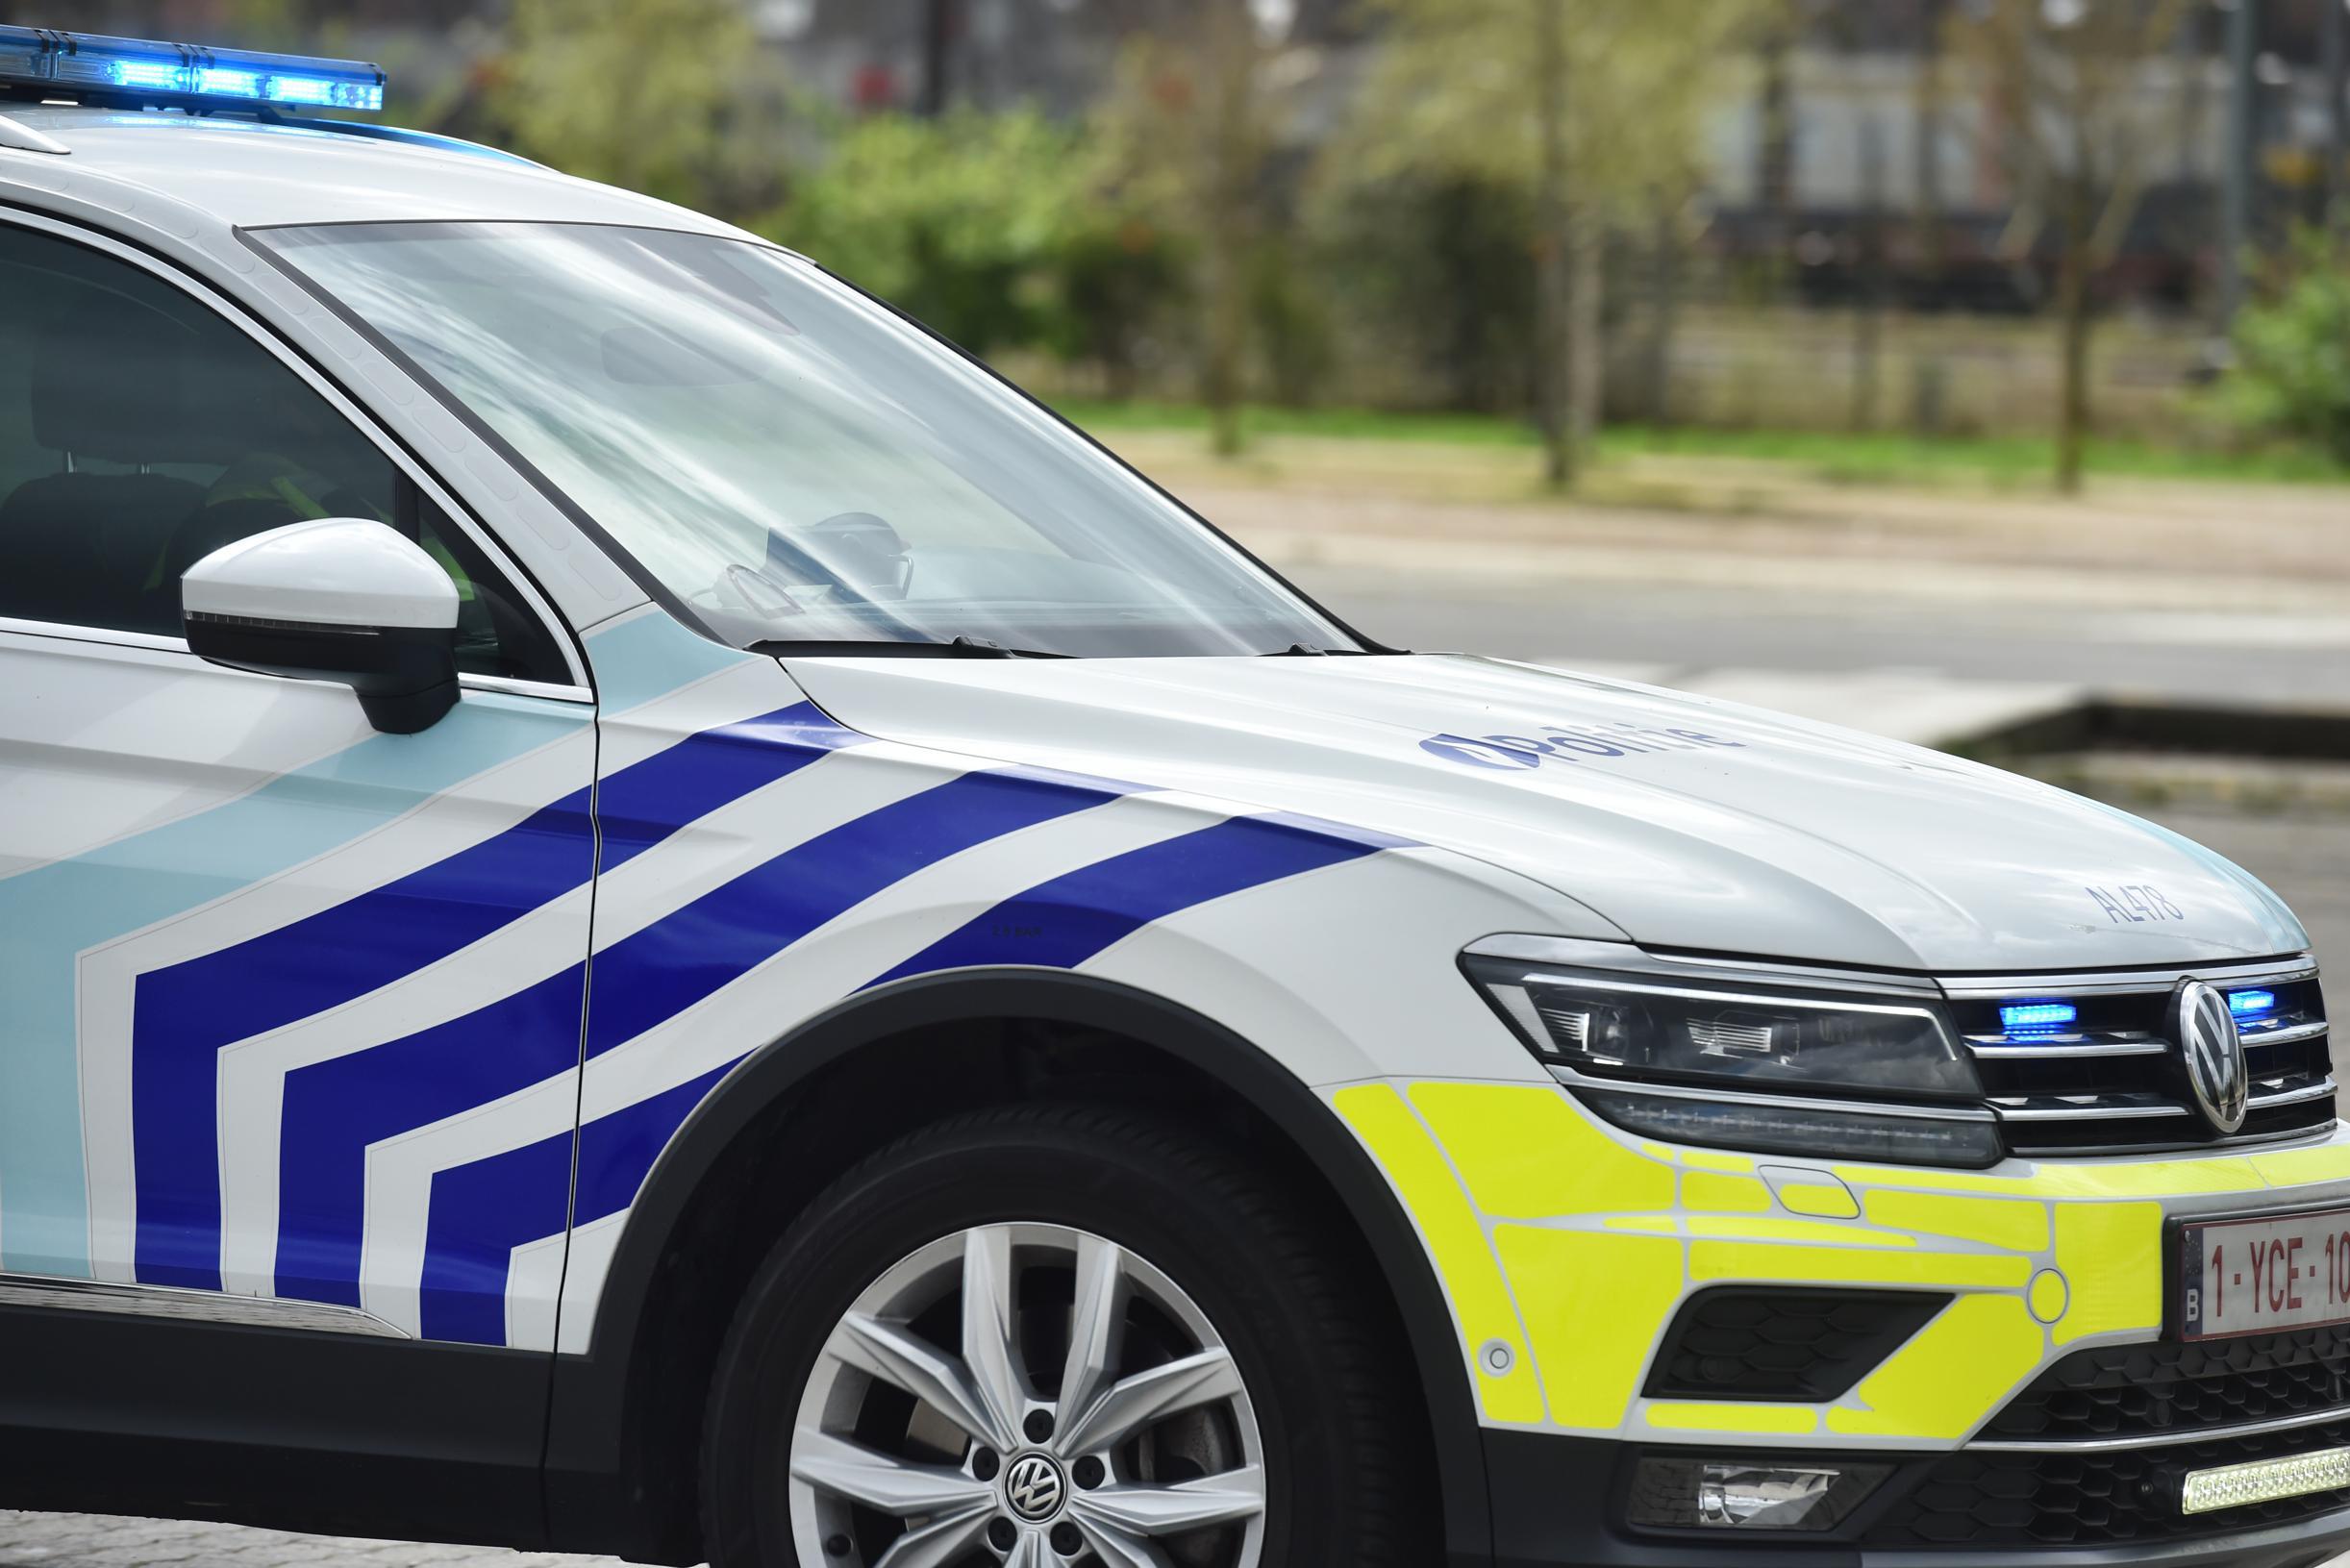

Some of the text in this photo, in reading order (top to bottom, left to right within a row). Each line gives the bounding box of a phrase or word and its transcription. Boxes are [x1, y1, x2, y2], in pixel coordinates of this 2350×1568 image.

[1481, 722, 1747, 761] Politie
[2085, 884, 2184, 924] AL478
[2186, 1288, 2200, 1322] B
